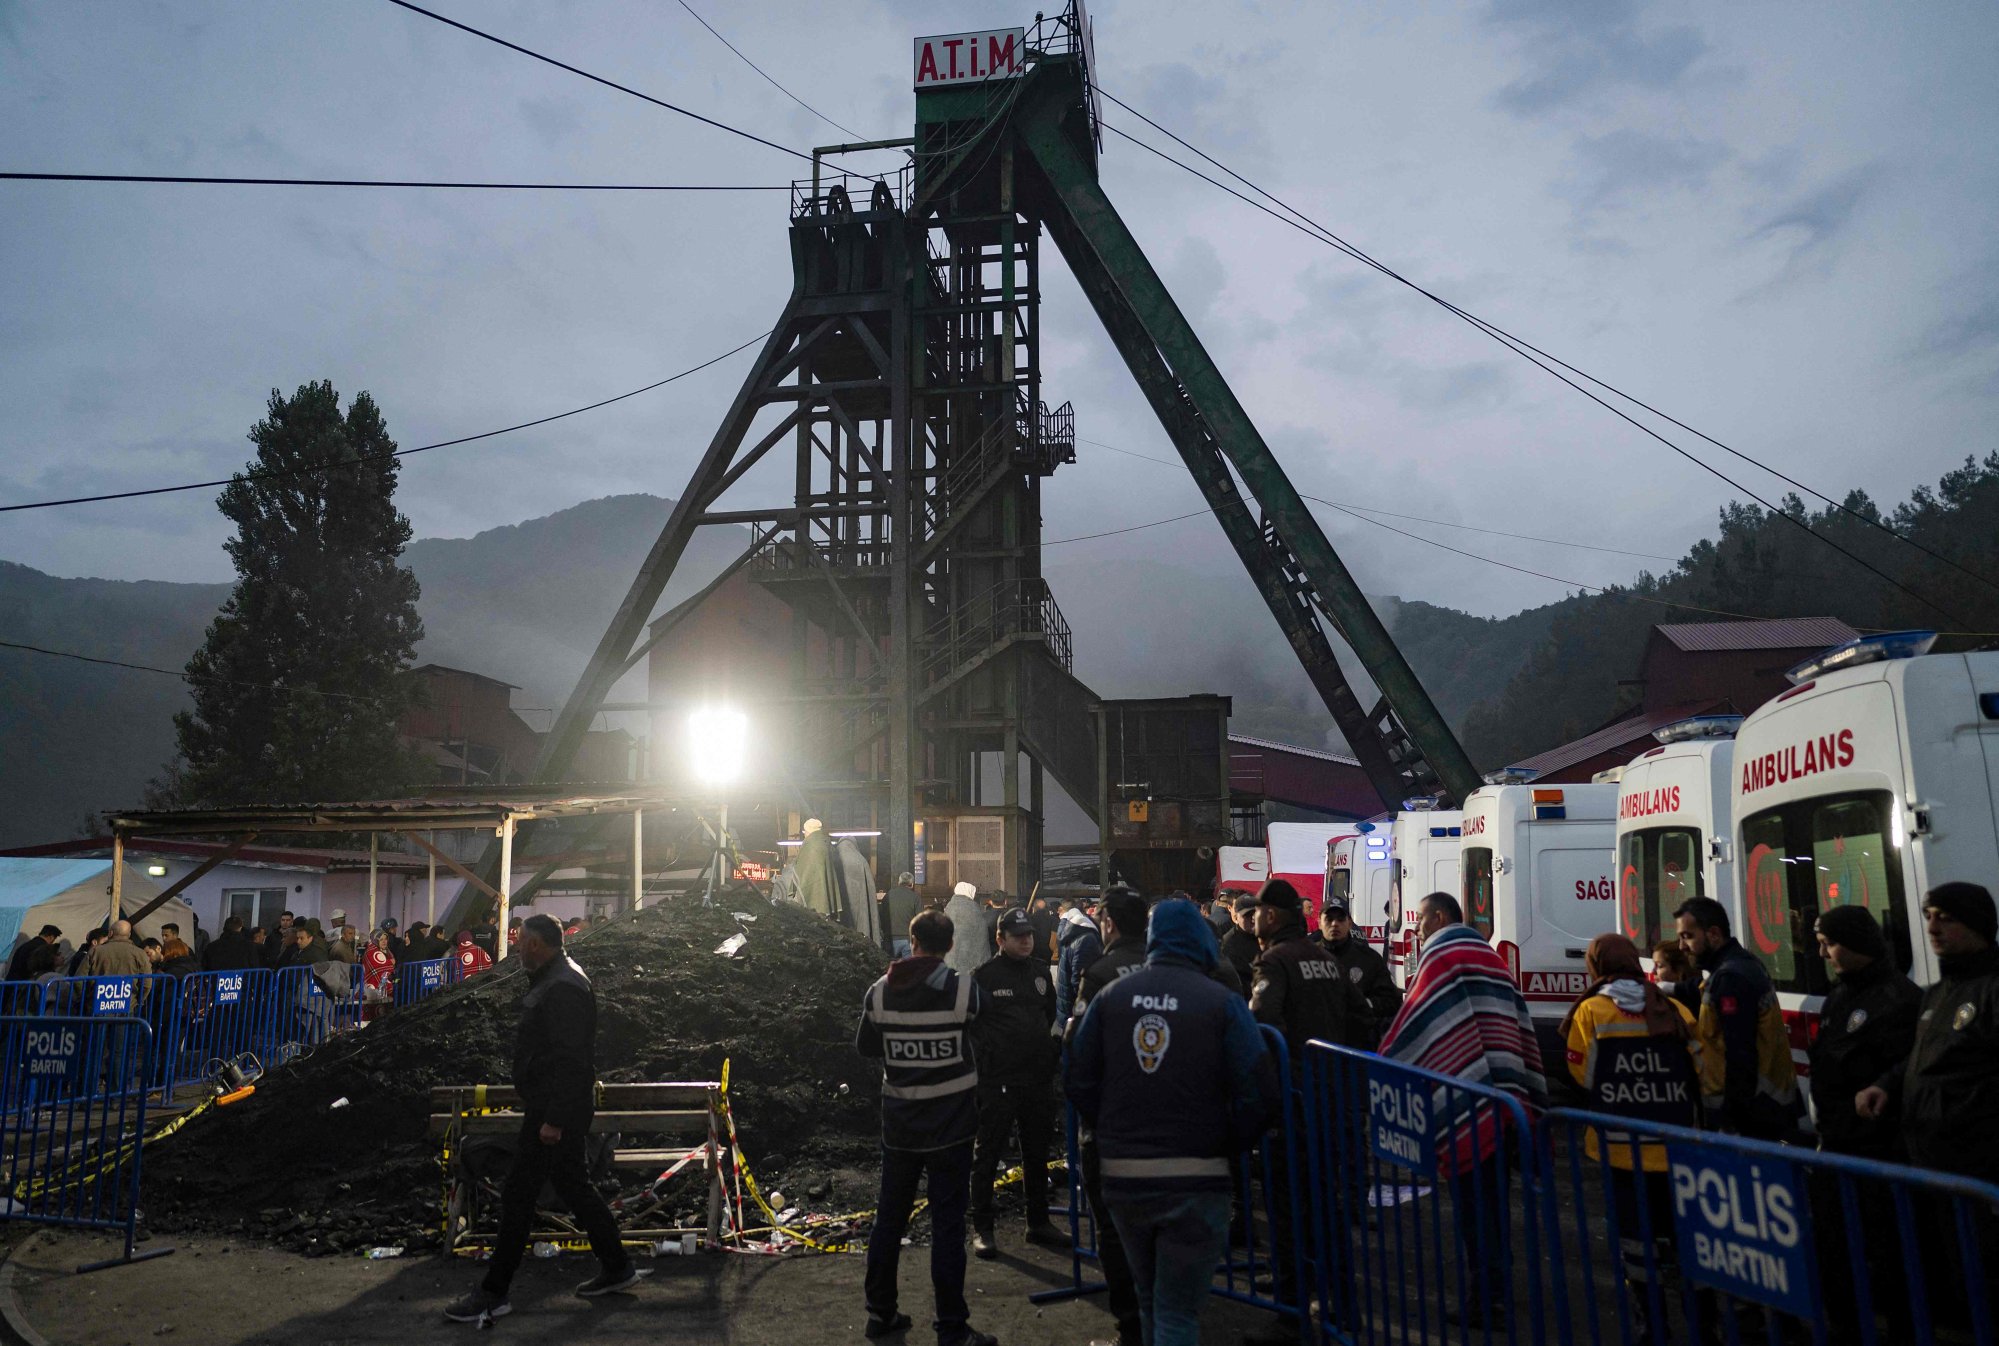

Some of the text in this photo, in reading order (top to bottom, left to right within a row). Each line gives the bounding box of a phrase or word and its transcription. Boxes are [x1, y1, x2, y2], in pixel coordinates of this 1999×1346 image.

[1742, 729, 1855, 795] AMBULANS
[1620, 785, 1680, 820] AMBULANS
[1462, 815, 1485, 837] BULANS
[217, 974, 243, 991] POLİS
[422, 963, 440, 978] POLİS
[96, 980, 131, 999] POLİS
[220, 992, 238, 1001] BARTIN
[1132, 993, 1178, 1011] POLİS
[99, 1000, 126, 1011] BARTIN
[26, 1026, 76, 1056] POLİS
[30, 1059, 67, 1075] BARTIN
[1614, 1047, 1670, 1073] ACİL
[1600, 1077, 1688, 1104] SAĞLIK
[1368, 1079, 1427, 1135] POLİS
[1378, 1126, 1421, 1165] BARTIN
[1672, 1163, 1799, 1248] POLİS
[1694, 1231, 1789, 1294] BARTIN
